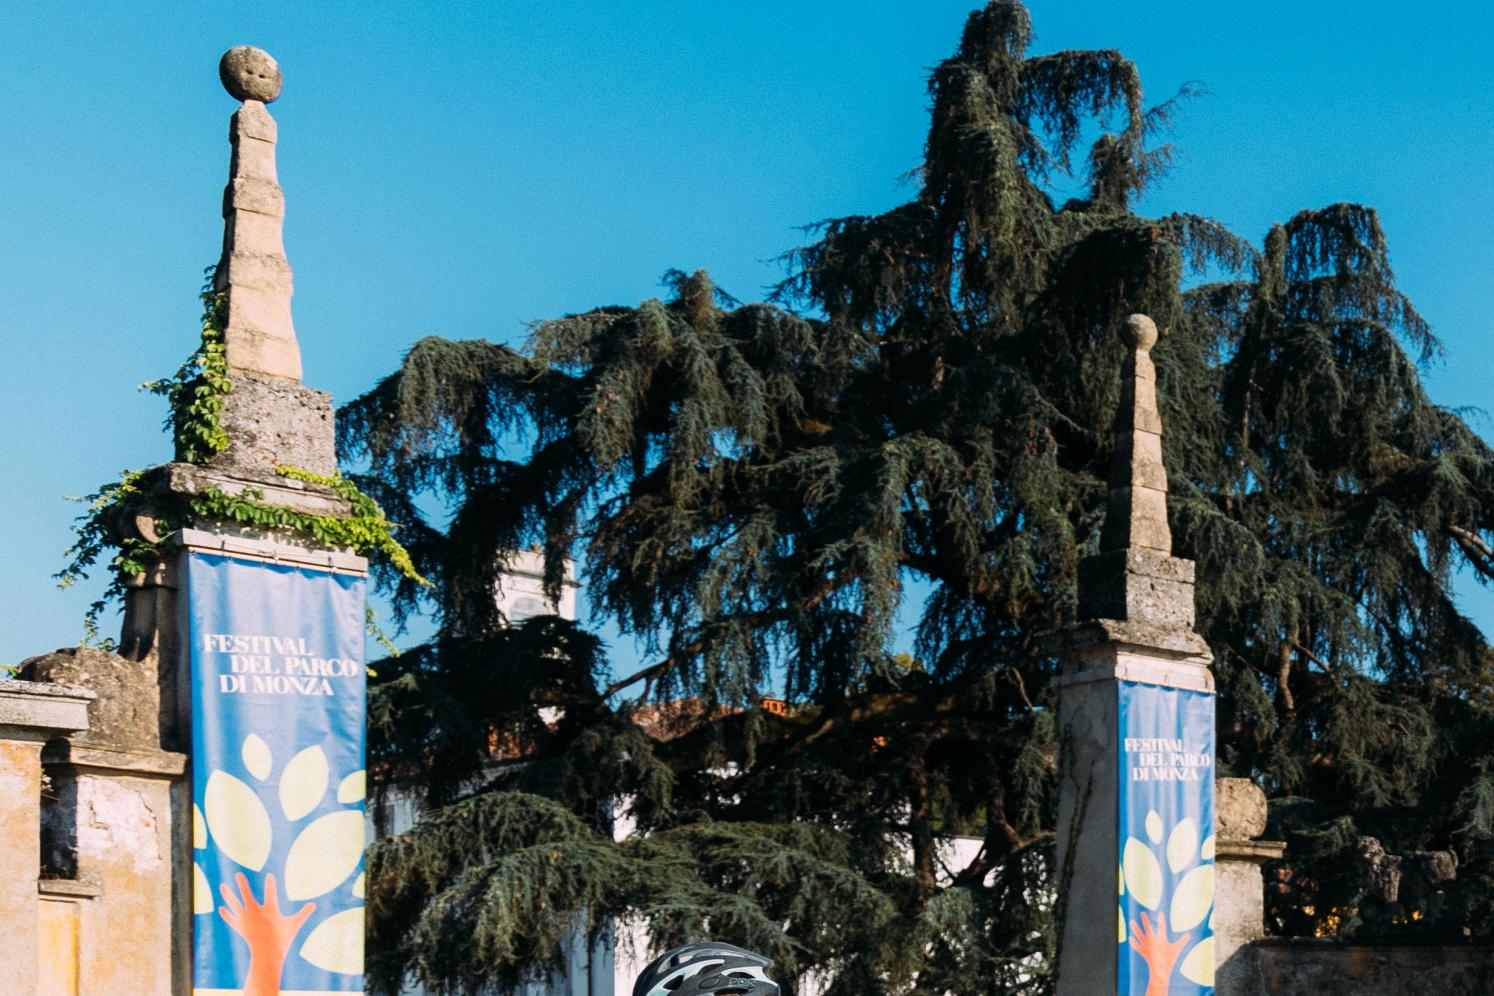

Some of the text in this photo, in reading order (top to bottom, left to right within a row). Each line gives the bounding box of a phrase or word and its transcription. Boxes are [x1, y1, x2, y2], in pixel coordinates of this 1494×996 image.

[203, 633, 313, 656] FESTIVAL
[230, 655, 358, 677] DEL PARCO
[219, 675, 334, 696] DI MONZA
[1125, 737, 1184, 752] FESTIVAL
[1140, 752, 1211, 768] DEL PARCO
[1132, 767, 1198, 781] DI MONZA
